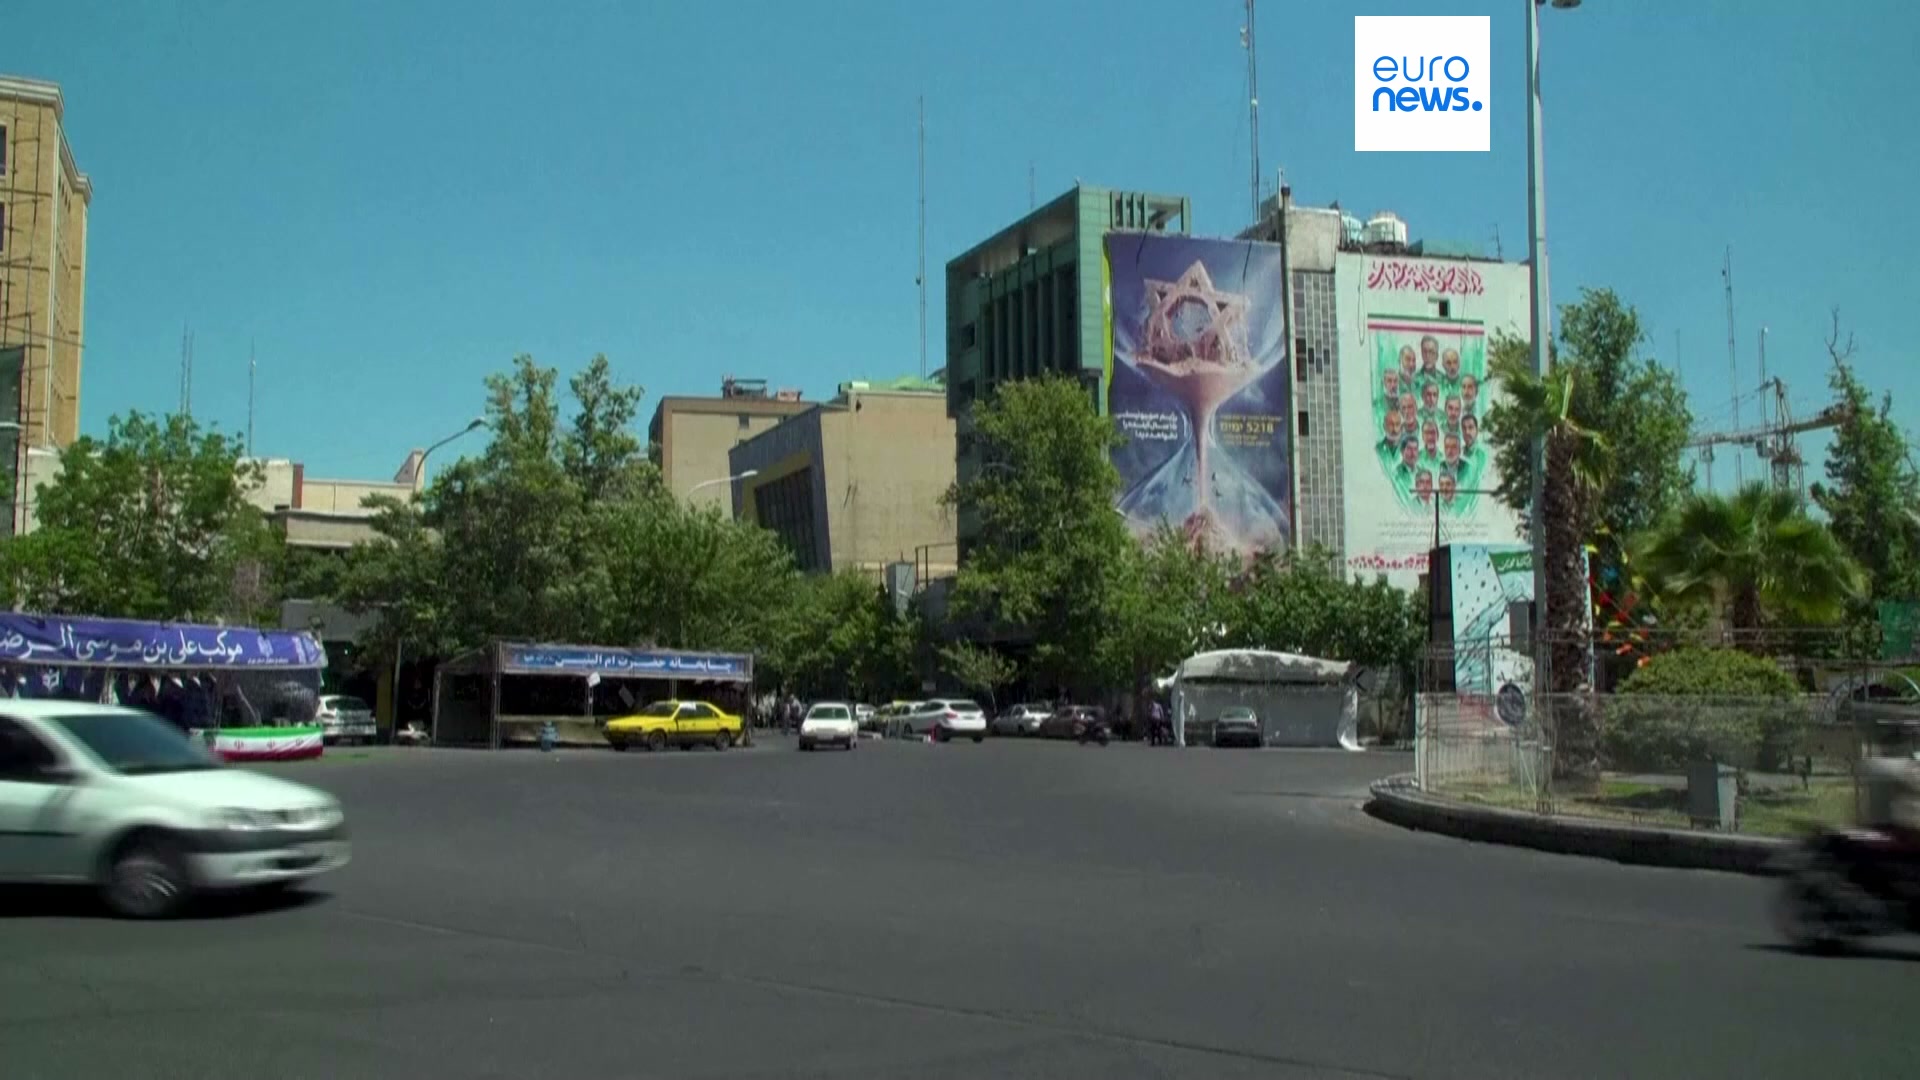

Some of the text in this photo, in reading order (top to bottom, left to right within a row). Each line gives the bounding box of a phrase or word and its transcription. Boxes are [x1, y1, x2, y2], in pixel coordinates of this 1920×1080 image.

[0, 622, 75, 660] الرض
[76, 638, 143, 662] موسی
[143, 638, 167, 664] بن
[168, 629, 198, 664] علی
[198, 630, 243, 664] موکب
